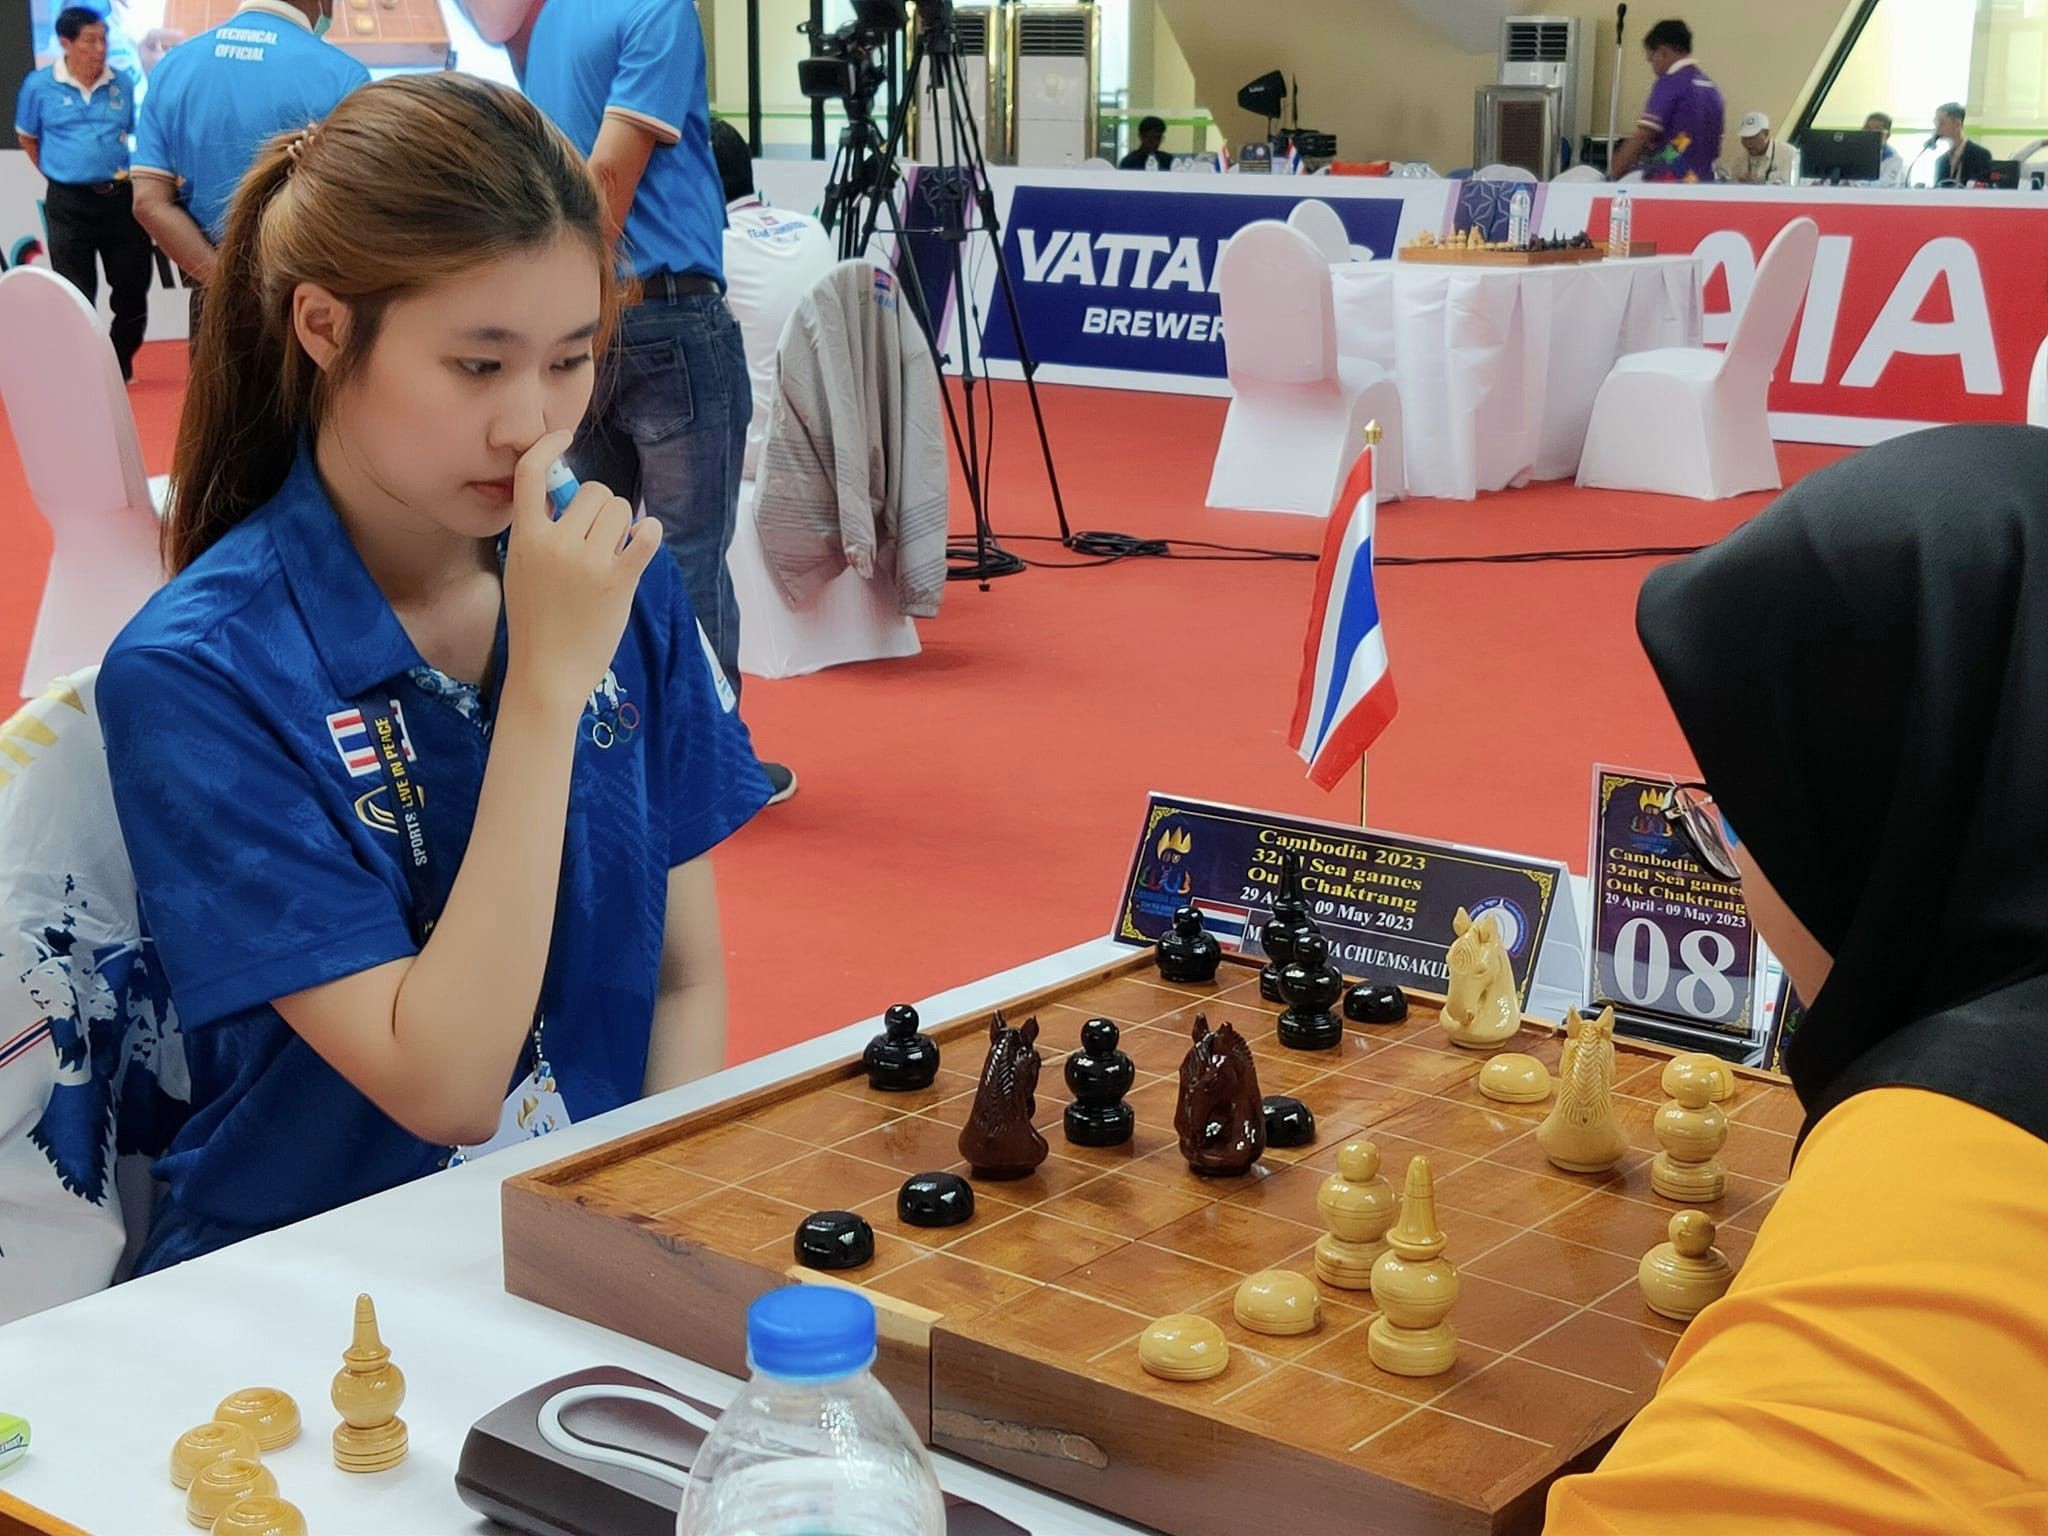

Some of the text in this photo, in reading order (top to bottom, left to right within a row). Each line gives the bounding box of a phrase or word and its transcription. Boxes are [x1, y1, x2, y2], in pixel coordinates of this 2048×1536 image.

[214, 43, 265, 61] OFFICIAL
[215, 27, 278, 45] TECHNICAL
[1017, 228, 1227, 294] VATTA
[375, 717, 427, 867] SPORTS LIVE IN PEACE
[1259, 829, 1426, 871] Cambodia 2023
[1609, 847, 1699, 873] Cambodia
[1247, 866, 1280, 885] Ou
[1301, 876, 1418, 913] Chaktrang
[1309, 857, 1347, 878] Sea
[1352, 868, 1422, 891] games
[1607, 862, 1649, 880] 32nd
[1655, 870, 1685, 886] Sea
[1240, 886, 1260, 901] 29
[1315, 900, 1334, 915] 09
[1337, 904, 1373, 926] May
[1375, 912, 1414, 931] 2023
[1605, 892, 1619, 904] 29
[1622, 896, 1654, 912] April
[1665, 904, 1681, 916] 09
[1684, 907, 1714, 926] May
[1716, 913, 1747, 928] 2023
[1606, 878, 1746, 915] Ouk Chaktrang
[1613, 917, 1736, 1019] 08
